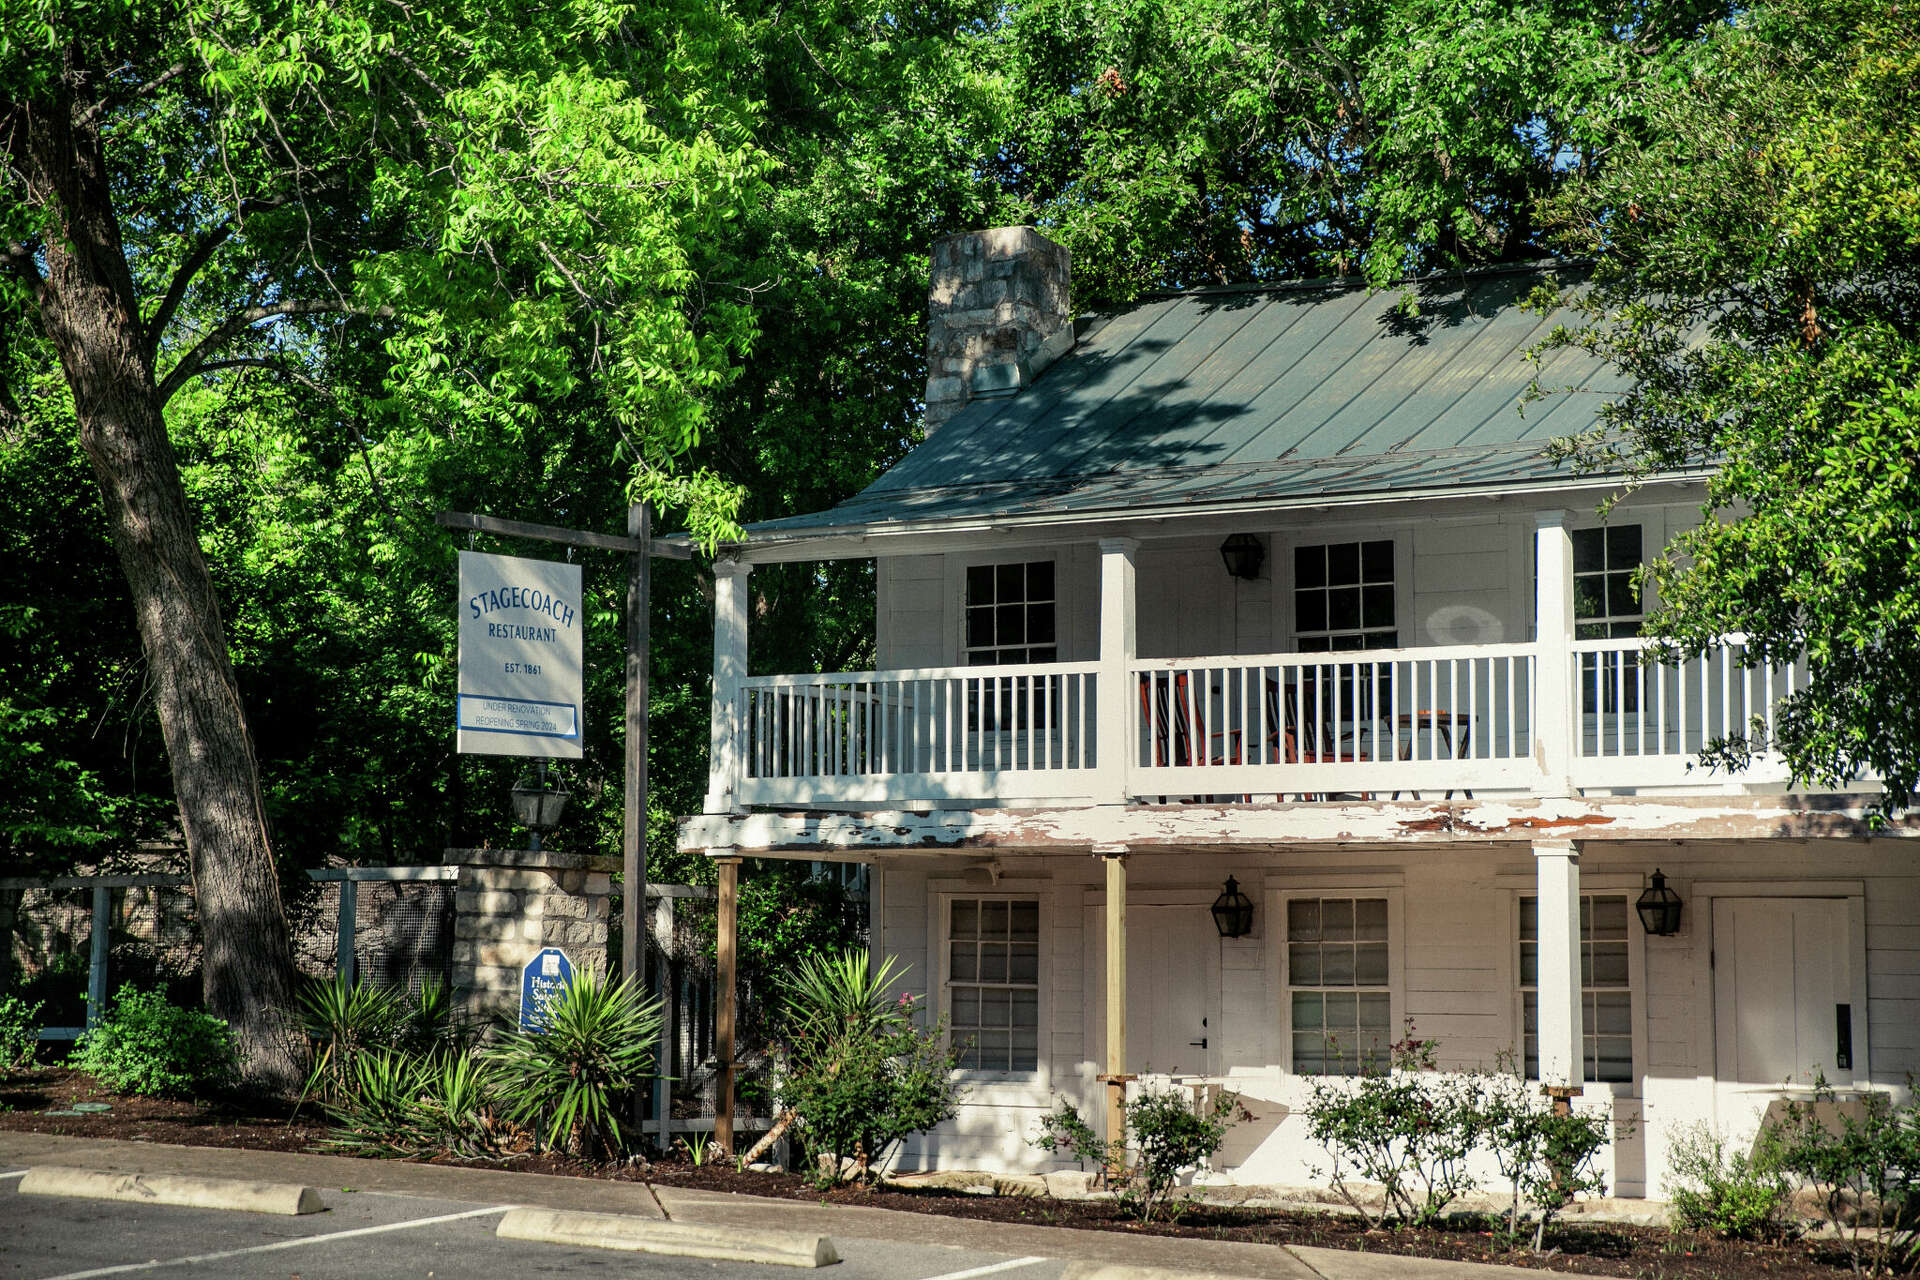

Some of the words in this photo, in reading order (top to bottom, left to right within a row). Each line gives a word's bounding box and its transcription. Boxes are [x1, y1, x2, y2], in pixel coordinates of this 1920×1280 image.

[470, 587, 574, 628] STAGECOACH
[488, 622, 557, 643] RESTAURANT
[504, 662, 522, 674] EST.
[524, 663, 542, 675] 1861
[482, 700, 507, 713] UNDER
[507, 703, 551, 717] RENOVATION
[475, 715, 514, 729] REOPENING
[515, 718, 540, 731] SPRING
[540, 720, 557, 733] 2024
[531, 976, 567, 989] Histoic
